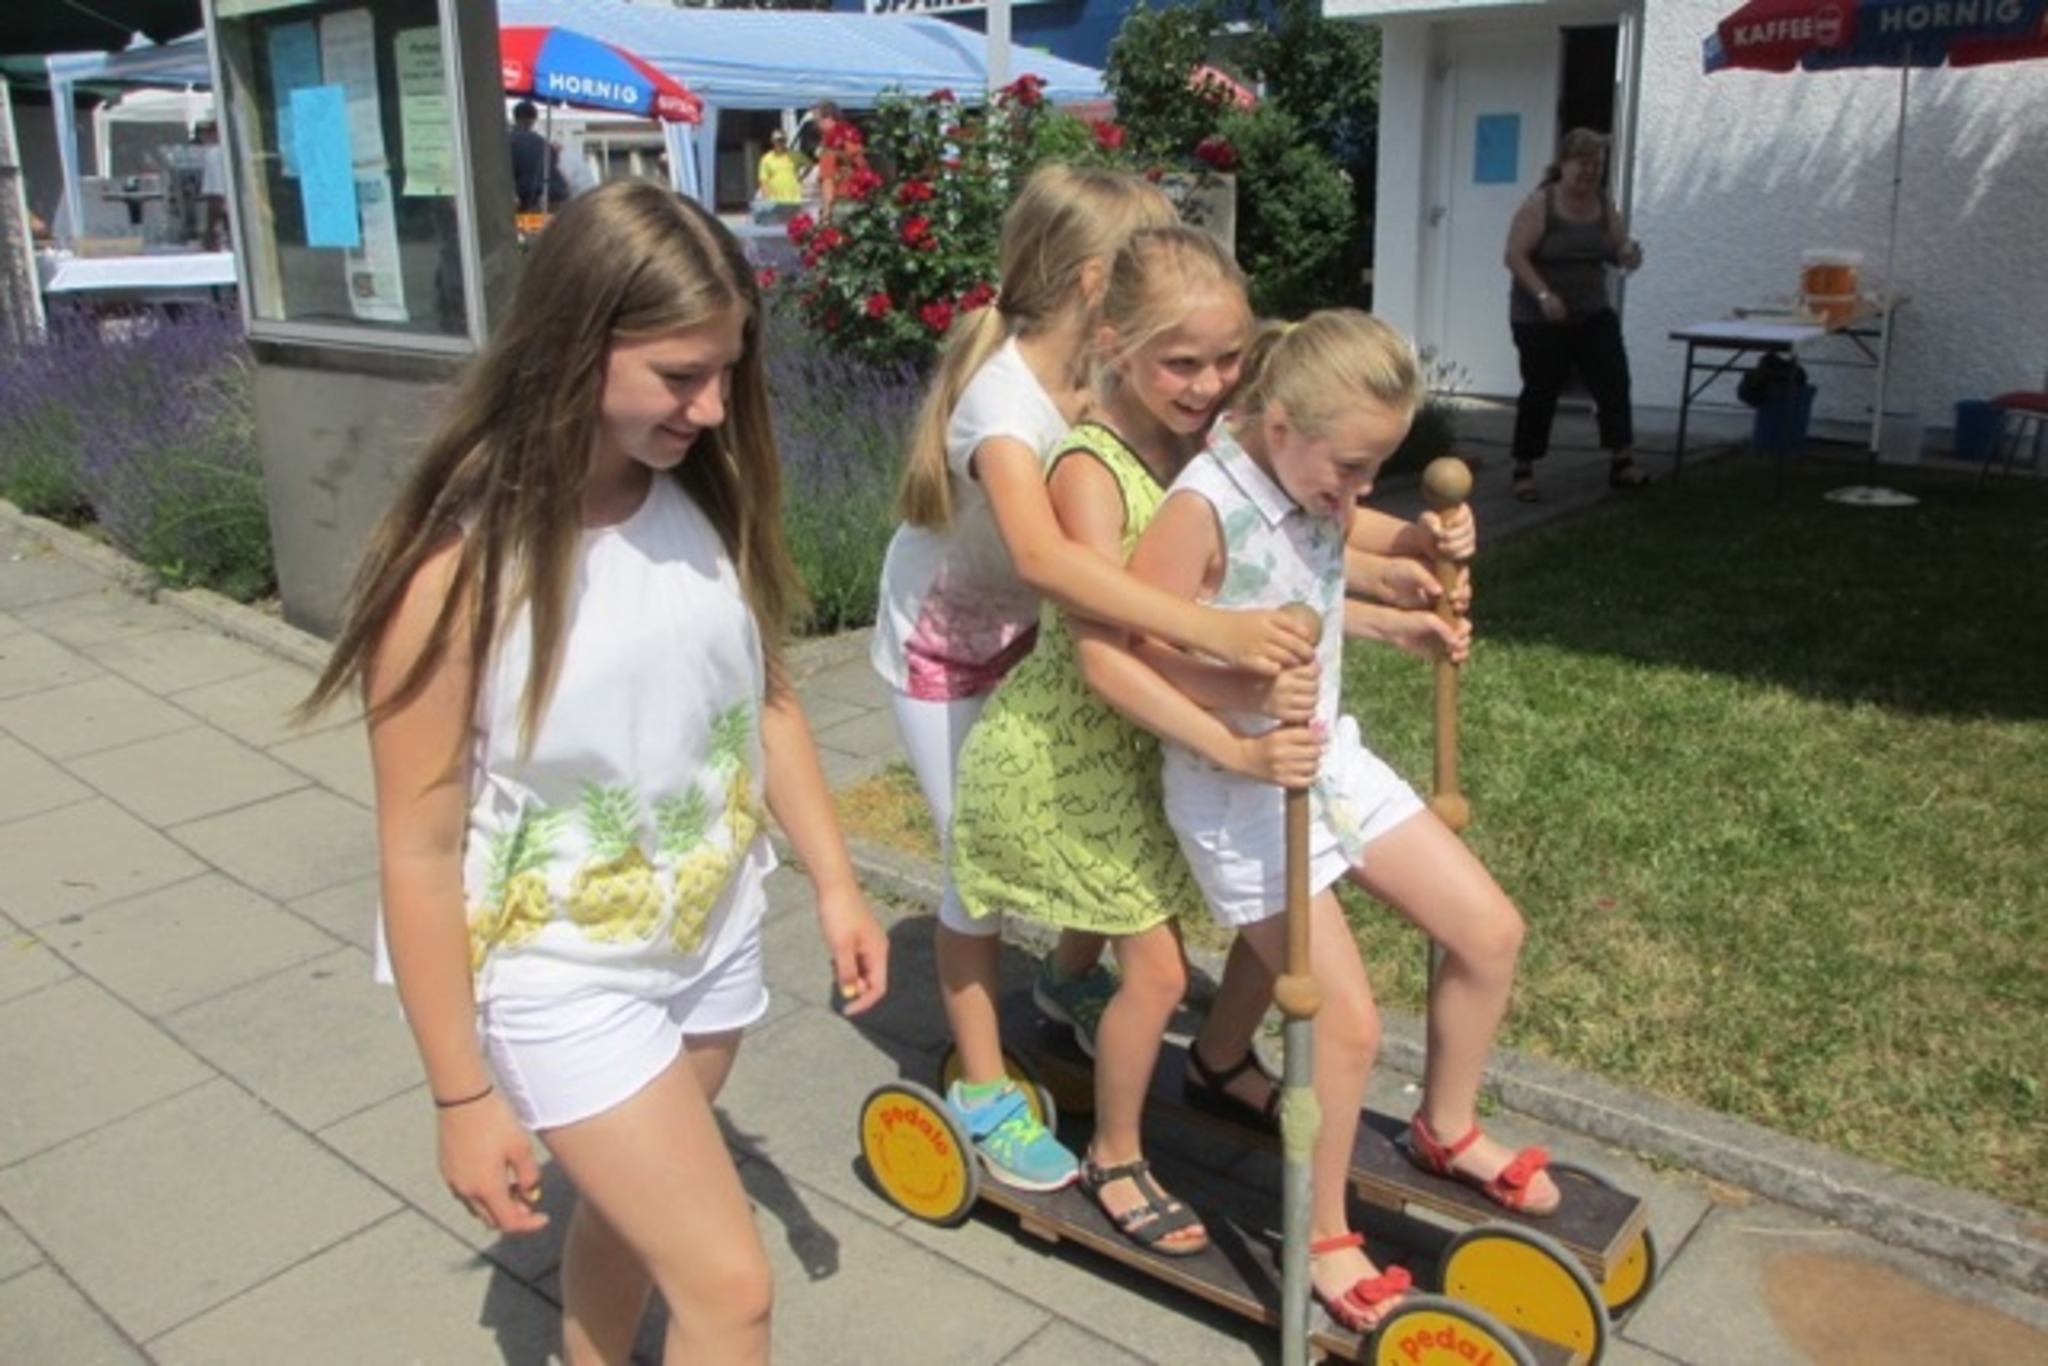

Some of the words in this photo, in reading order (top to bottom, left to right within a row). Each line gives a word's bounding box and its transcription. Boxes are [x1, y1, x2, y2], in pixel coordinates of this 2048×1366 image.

[1733, 16, 1812, 47] KAFFEE
[1880, 0, 2023, 33] HORNIG
[549, 72, 639, 104] HORNIG
[880, 1105, 949, 1156] pedalo
